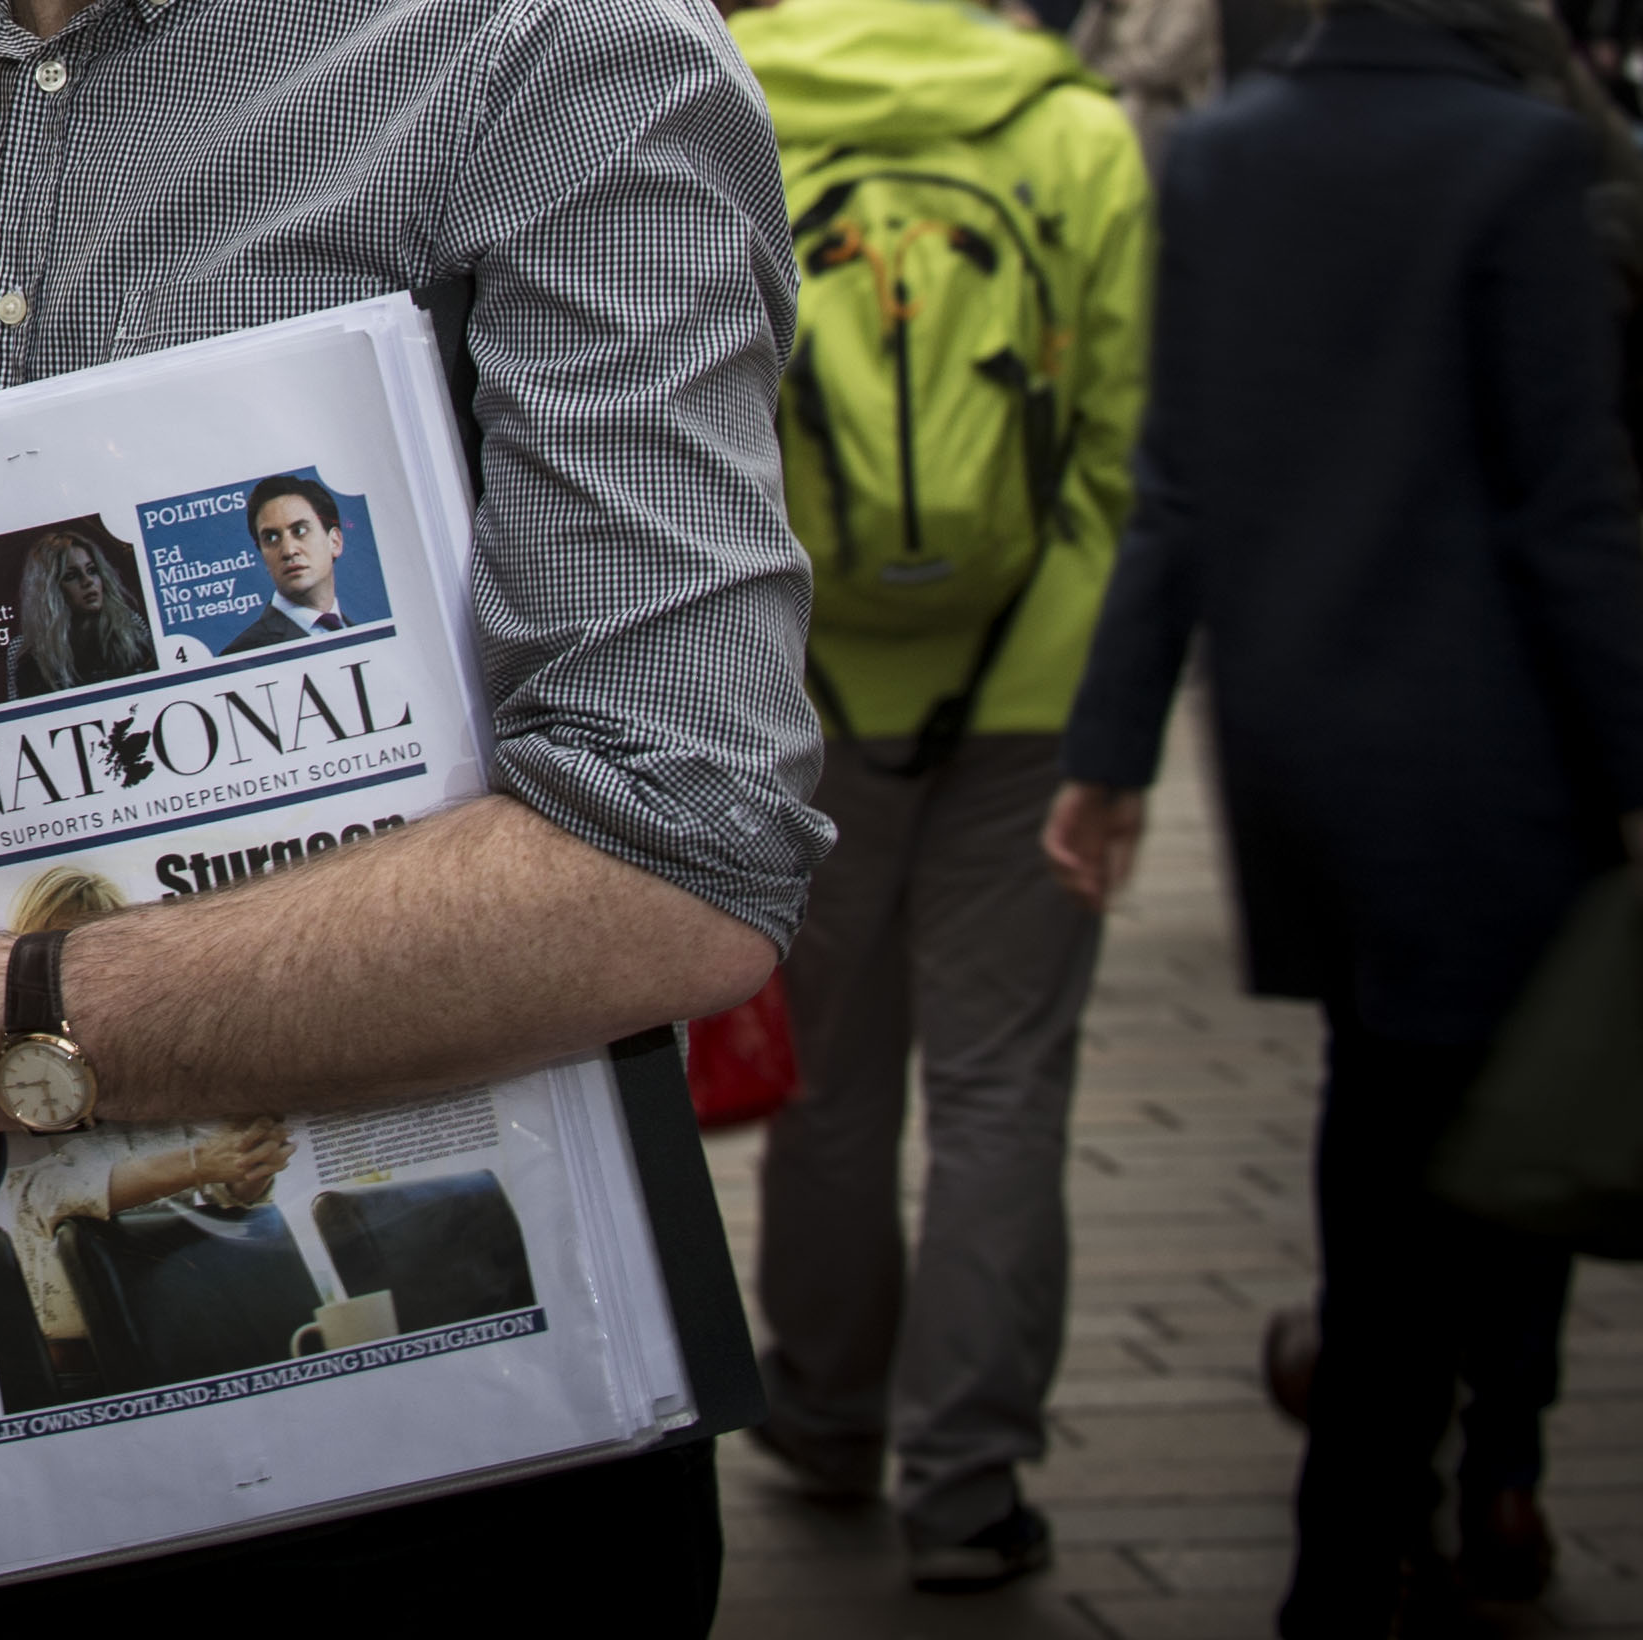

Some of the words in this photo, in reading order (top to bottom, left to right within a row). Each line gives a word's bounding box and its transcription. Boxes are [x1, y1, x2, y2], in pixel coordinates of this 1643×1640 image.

[143, 490, 247, 530] POLITICS
[152, 545, 183, 567] Ed
[156, 550, 256, 587] Miliband:
[159, 585, 191, 606] No
[193, 578, 236, 599] way
[164, 605, 192, 626] I'll
[195, 592, 263, 619] resign
[175, 646, 188, 663] 4
[0, 813, 105, 848] SUPPORTS
[111, 804, 139, 825] AN
[145, 768, 299, 822] INDEPENDENT
[307, 741, 423, 782] SCOTLAND
[28, 1408, 91, 1434] OWNS
[89, 1385, 216, 1424] SCOTLAND:
[217, 1376, 249, 1401] AN
[250, 1354, 359, 1394] AMAZING
[361, 1314, 535, 1368] INVESTIGATION
